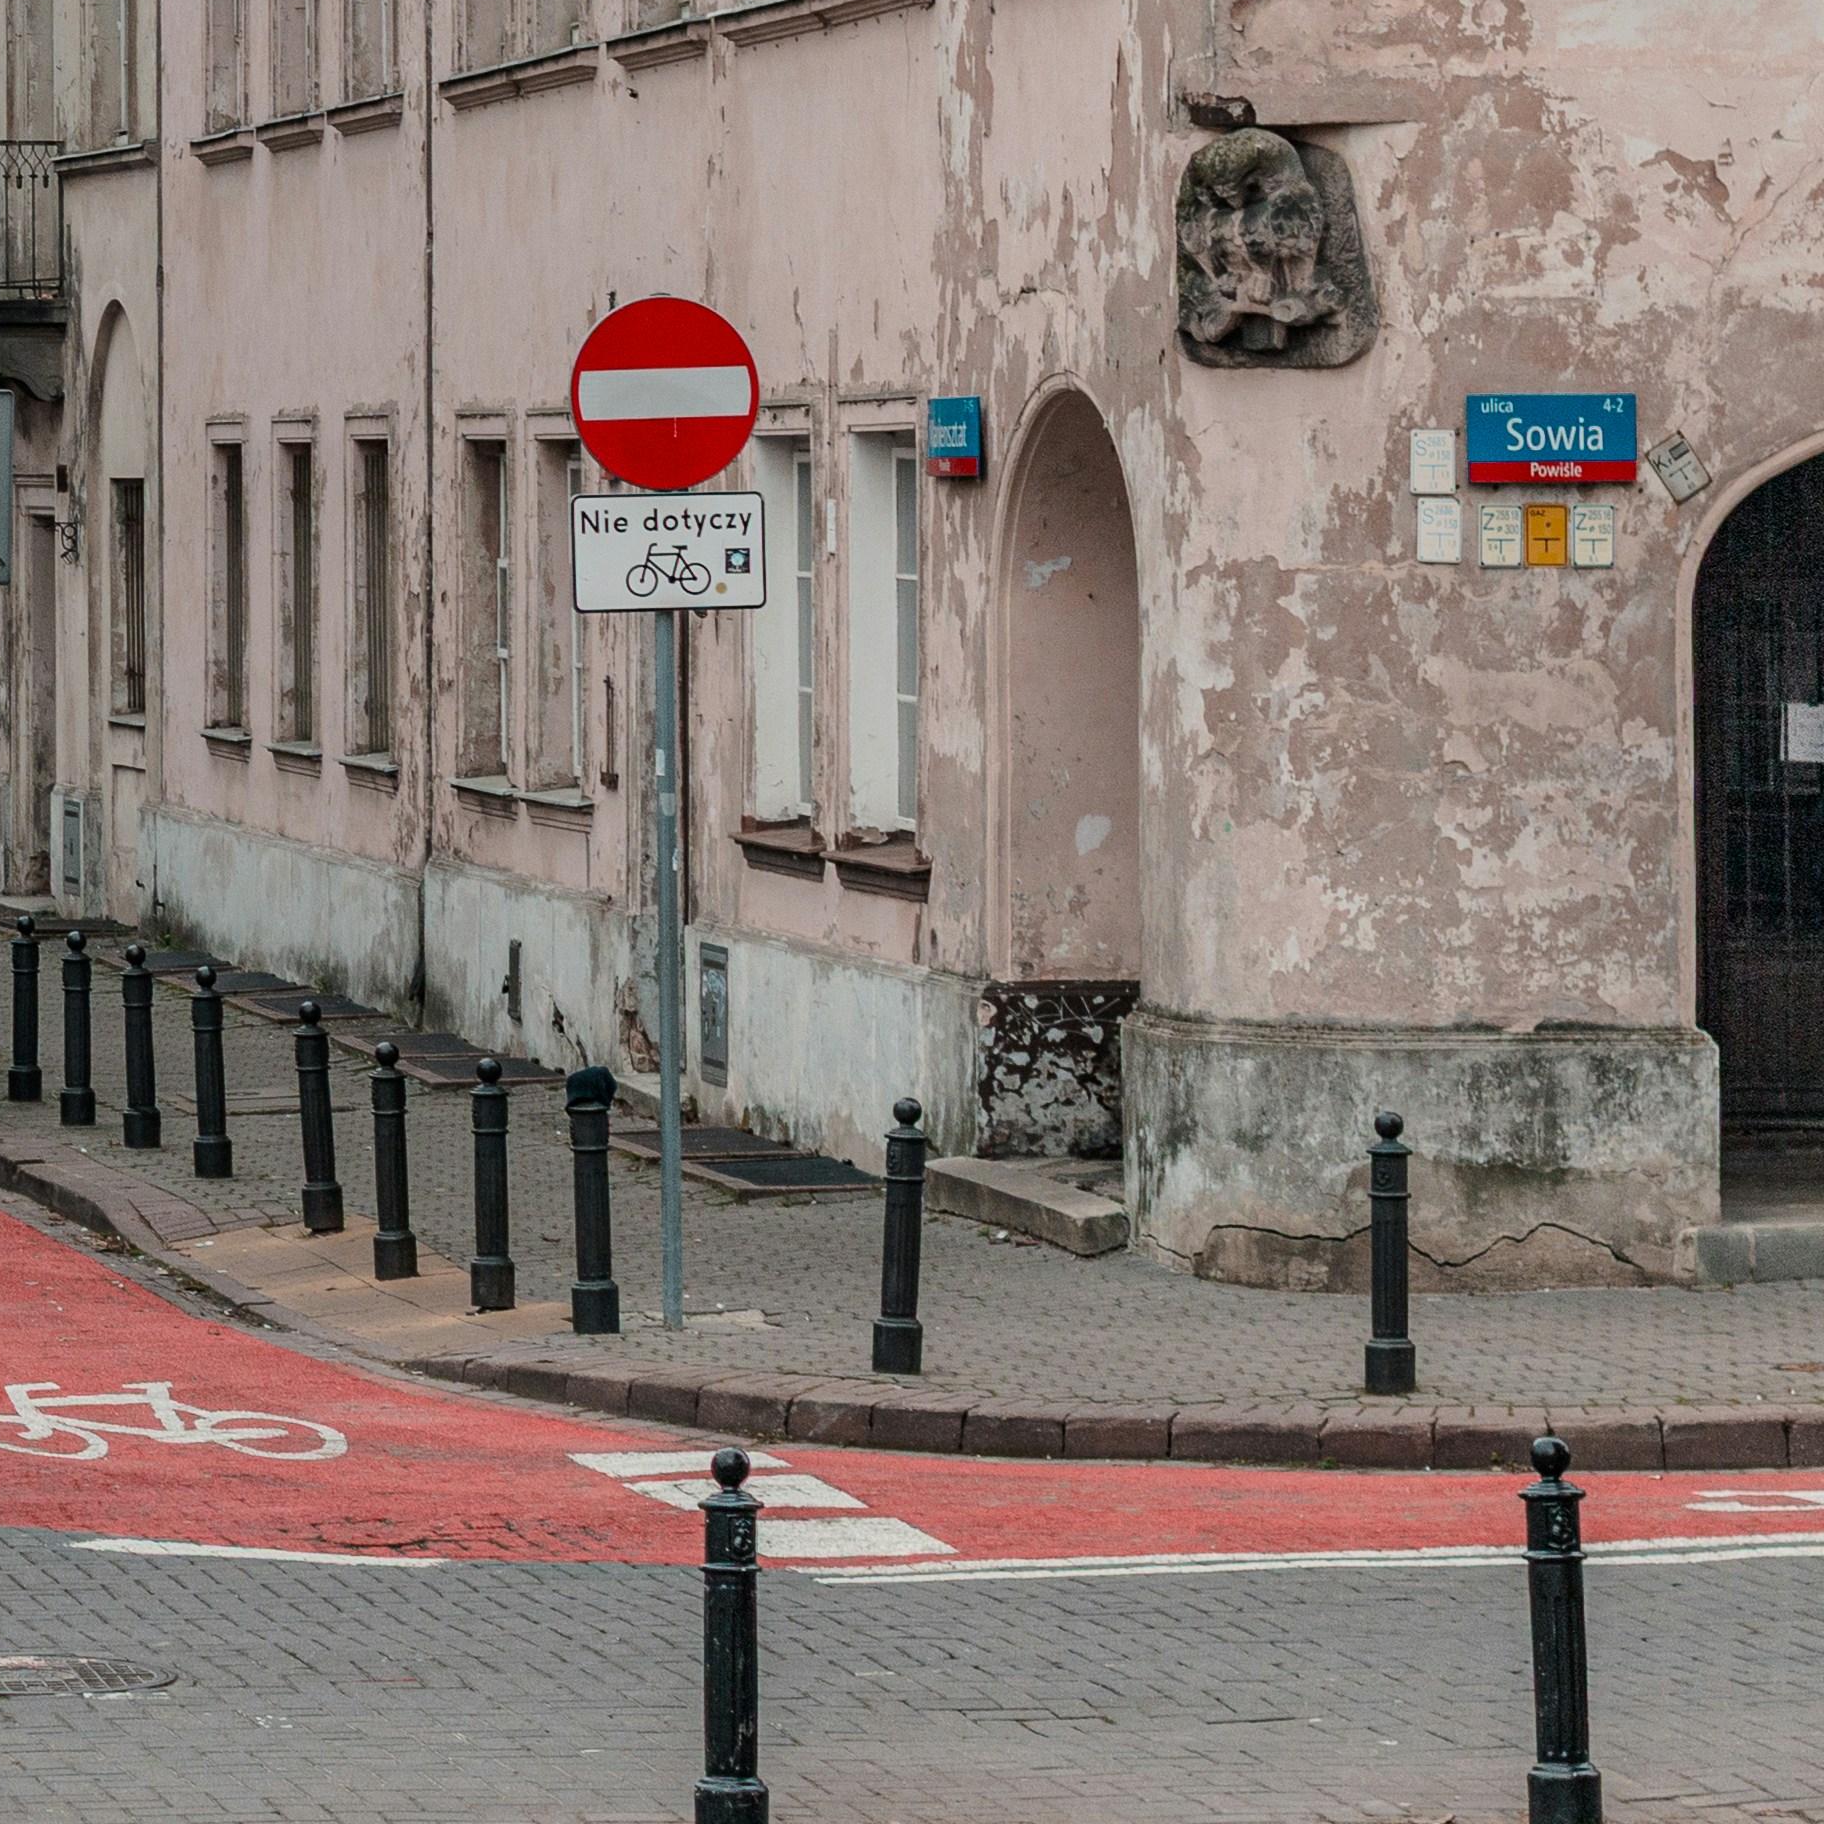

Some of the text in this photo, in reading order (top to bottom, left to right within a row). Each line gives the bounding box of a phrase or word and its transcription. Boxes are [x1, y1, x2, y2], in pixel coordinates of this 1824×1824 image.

[1481, 398, 1624, 413] ulica 4-2
[1506, 416, 1605, 452] Sowia
[1530, 462, 1583, 478] Powiśle
[580, 508, 752, 537] Nie dotyczy
